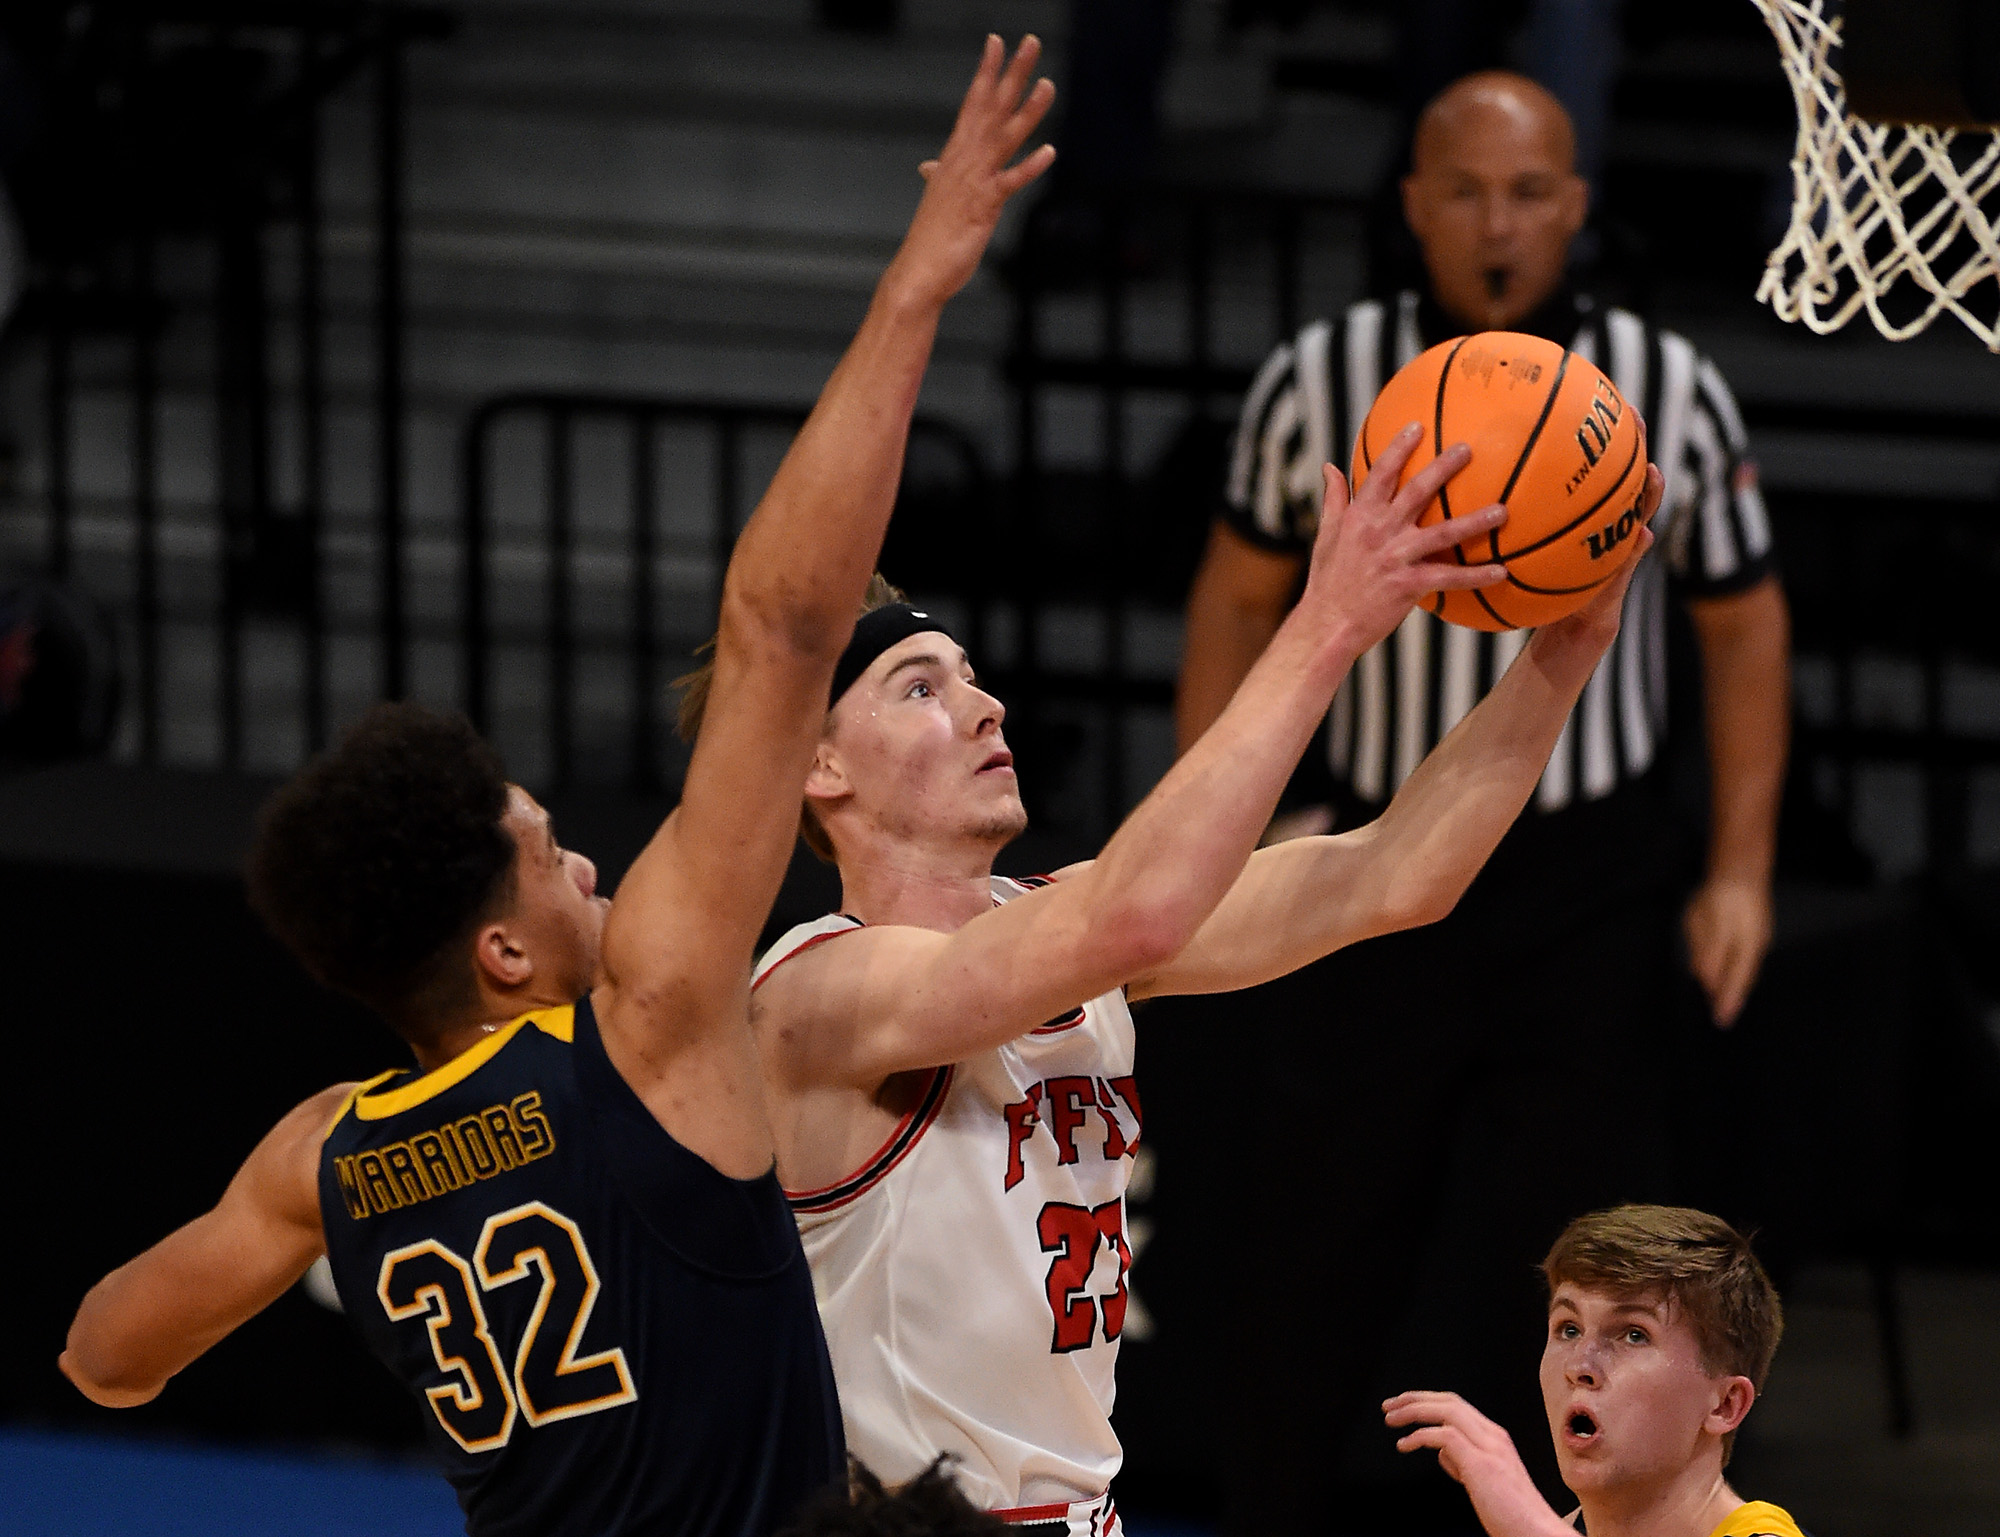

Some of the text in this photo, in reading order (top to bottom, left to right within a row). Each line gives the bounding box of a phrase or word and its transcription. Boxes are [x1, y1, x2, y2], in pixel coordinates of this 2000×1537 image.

[1565, 377, 1622, 495] EVO NXT
[333, 1090, 556, 1220] WARRIORS
[376, 1200, 639, 1454] 32
[1036, 1196, 1132, 1354] 23
